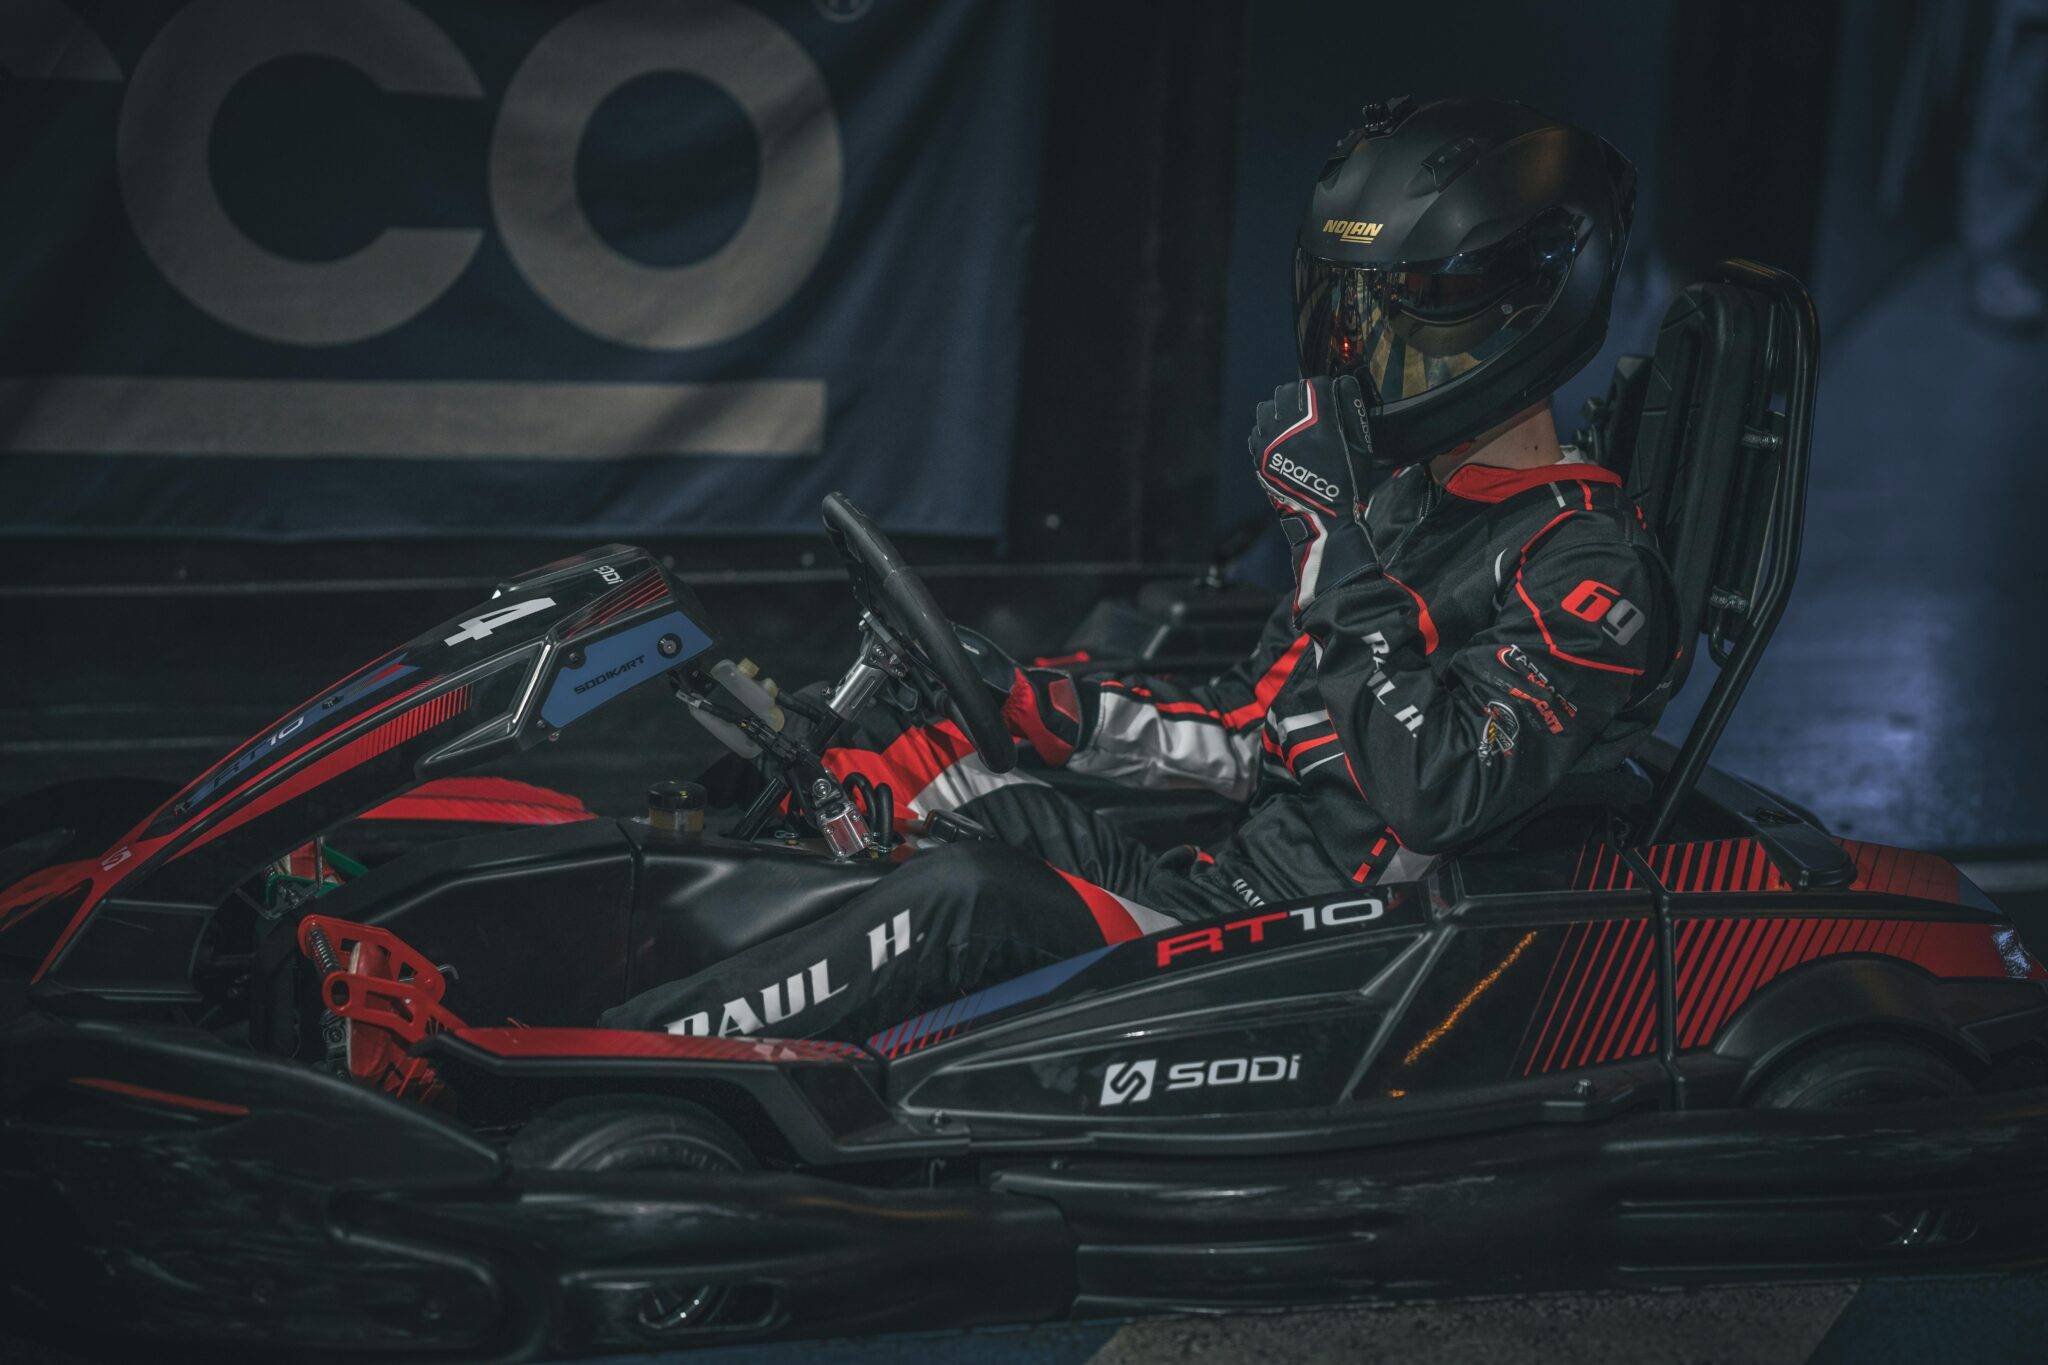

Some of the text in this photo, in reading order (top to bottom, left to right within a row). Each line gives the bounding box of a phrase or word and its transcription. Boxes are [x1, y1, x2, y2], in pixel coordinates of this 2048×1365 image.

[1322, 219, 1384, 241] NOLAN
[1273, 453, 1340, 498] sparco
[443, 597, 557, 647] 4
[1560, 579, 1646, 646] 69
[574, 654, 646, 695] SODIKART
[1156, 898, 1385, 968] RT10
